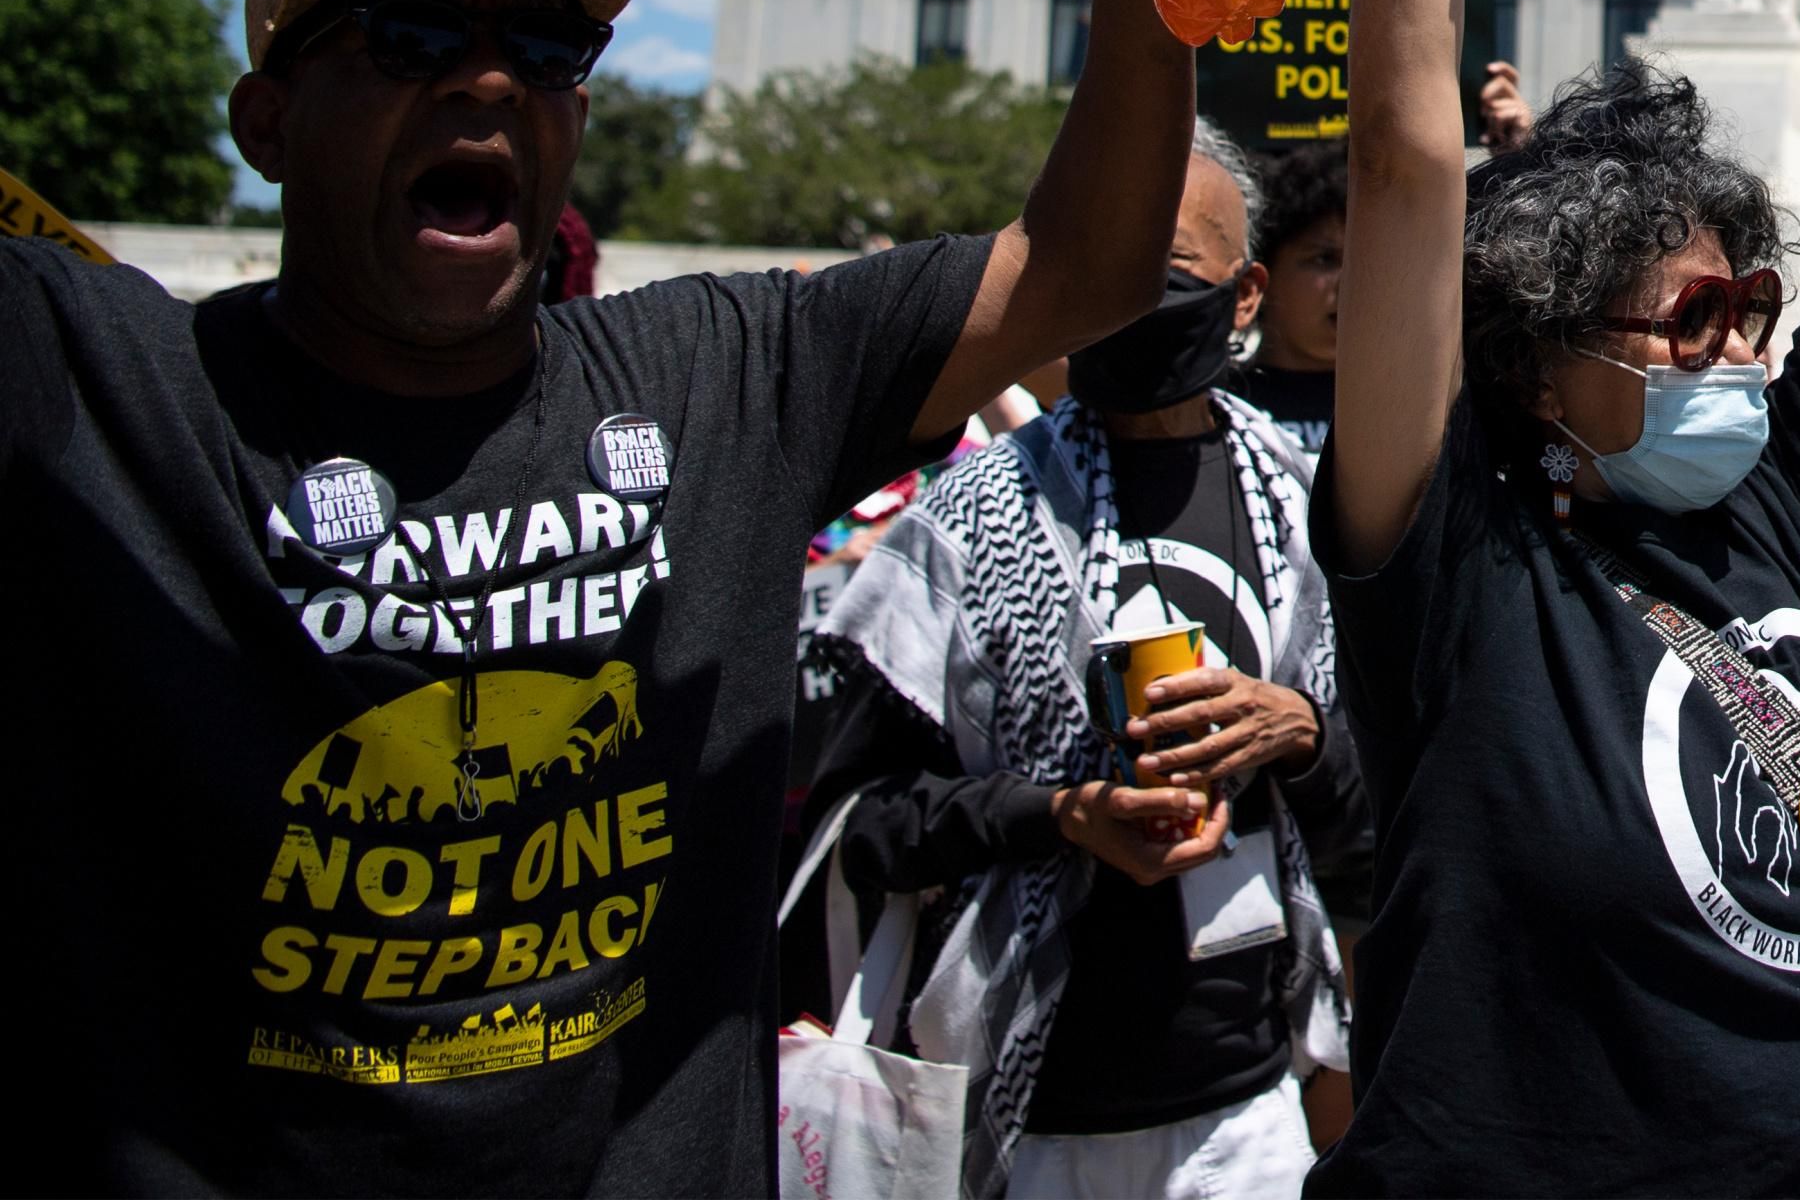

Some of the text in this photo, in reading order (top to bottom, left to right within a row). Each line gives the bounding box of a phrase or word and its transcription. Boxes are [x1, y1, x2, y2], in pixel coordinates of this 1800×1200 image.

[606, 447, 666, 470] VOTERS
[609, 466, 670, 490] MATTER
[309, 491, 381, 523] VOTERS
[313, 512, 386, 545] MATTER
[1161, 544, 1181, 562] DC
[262, 781, 673, 918] NOT ONE
[1697, 881, 1752, 944] BLACK
[251, 926, 484, 1001] STEP
[254, 1027, 399, 1067] REPAIRERS
[409, 1038, 541, 1065] Poor People's Campaign
